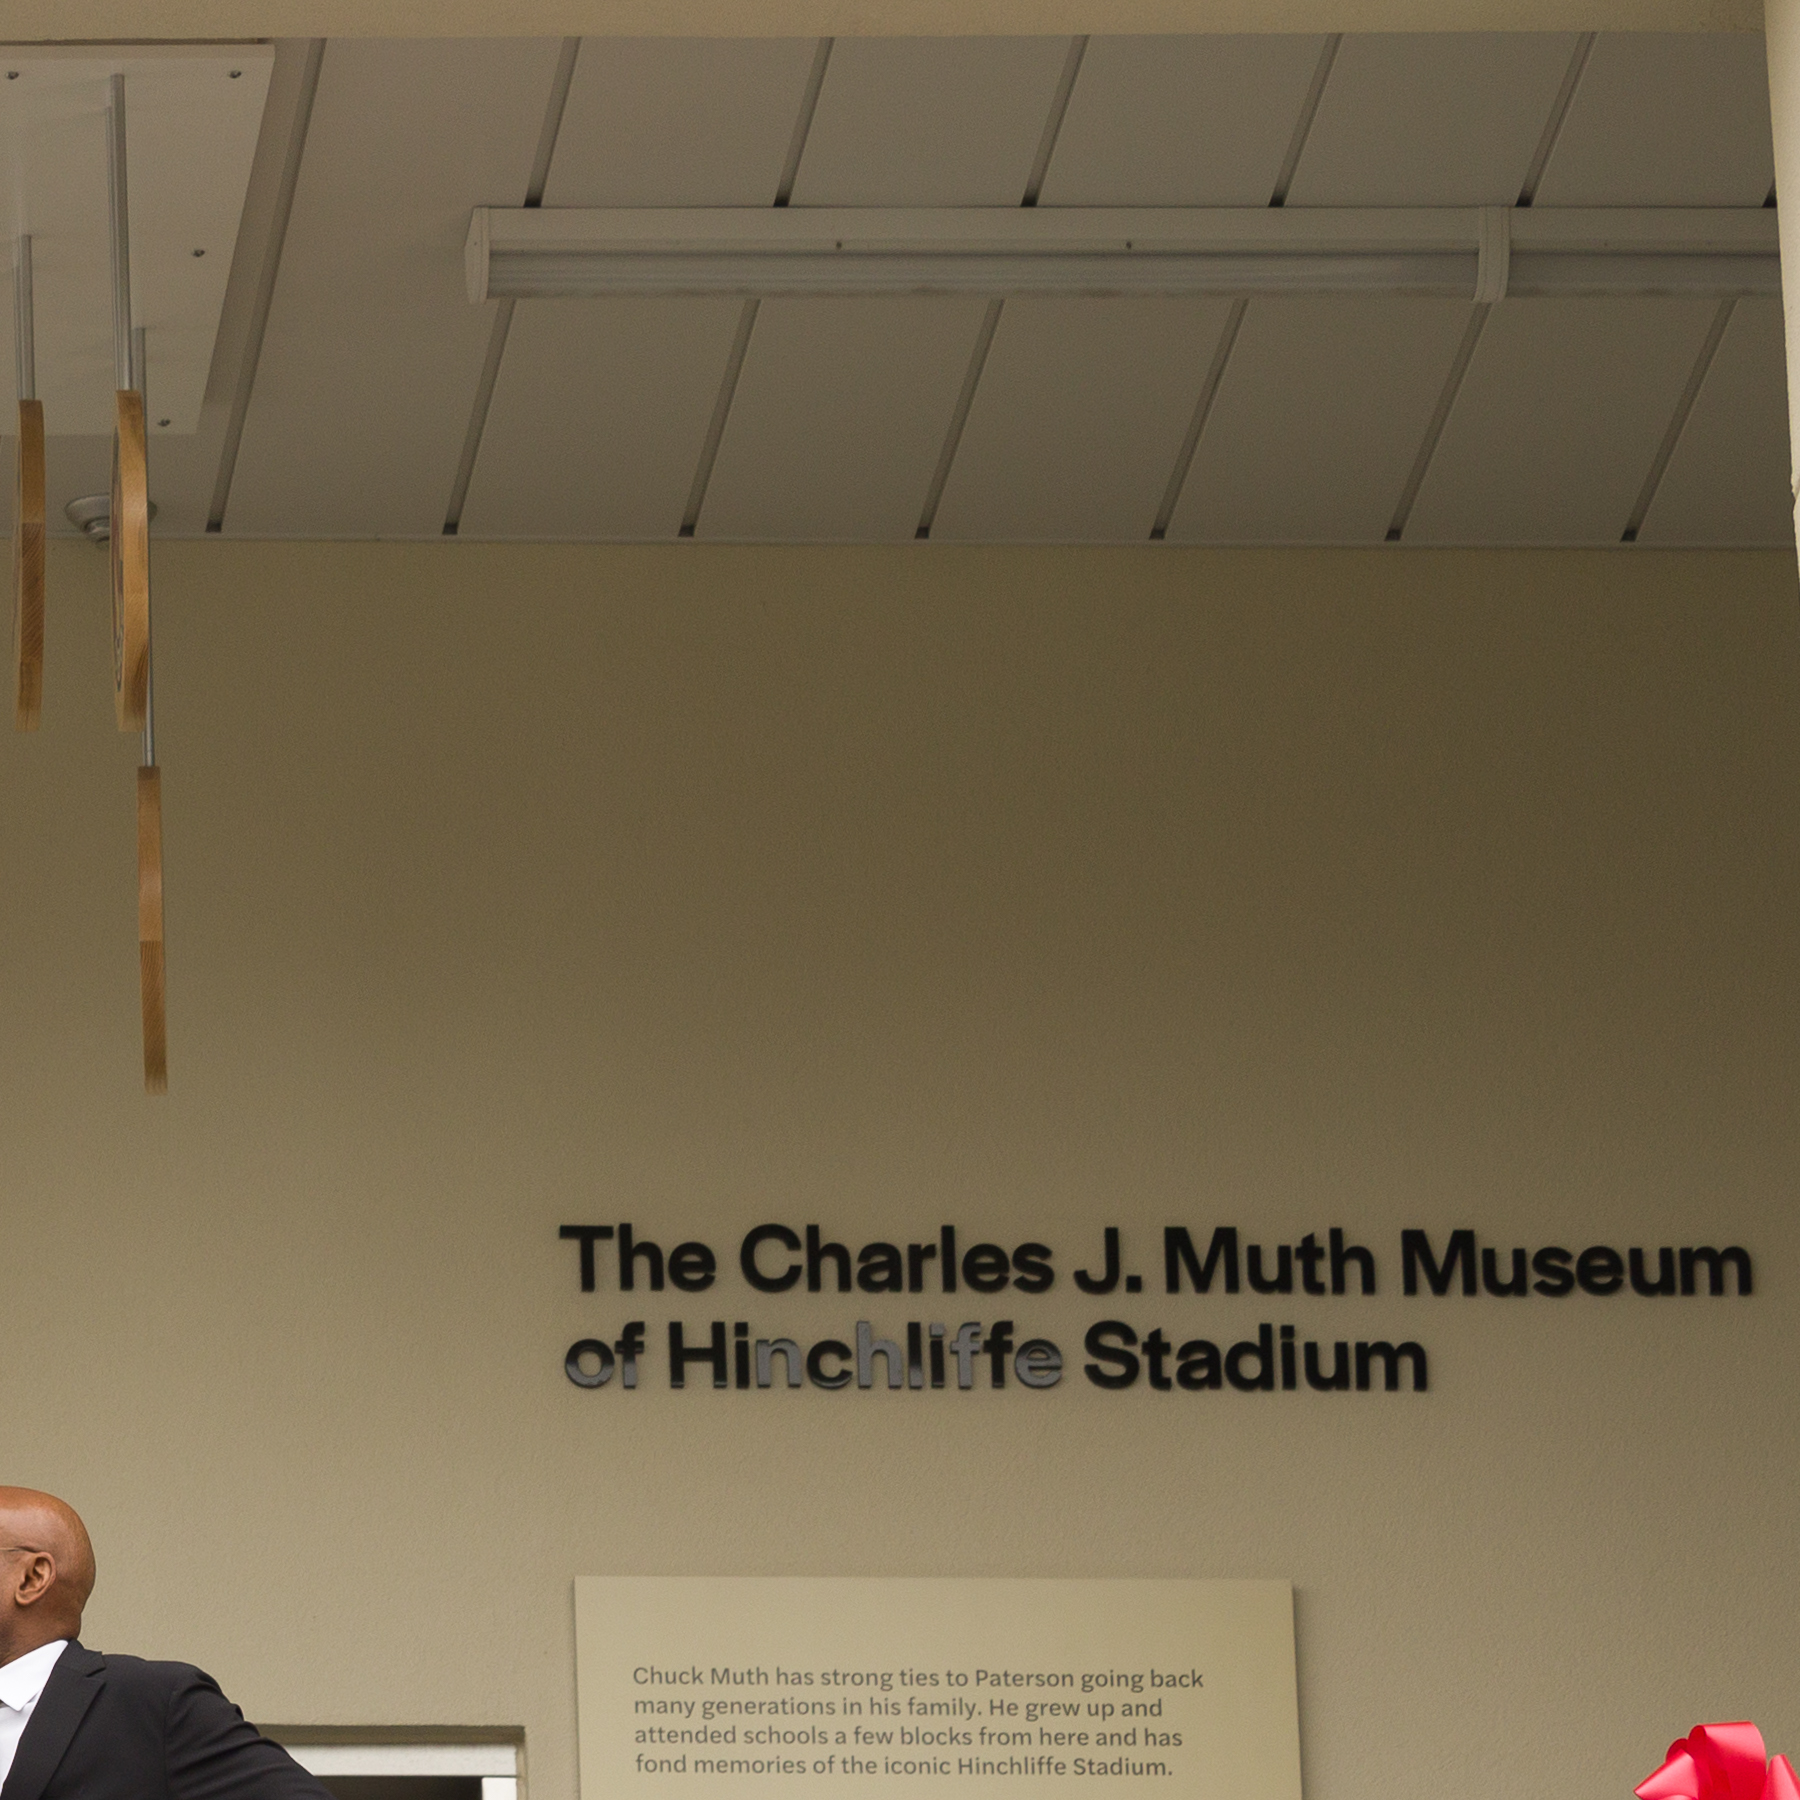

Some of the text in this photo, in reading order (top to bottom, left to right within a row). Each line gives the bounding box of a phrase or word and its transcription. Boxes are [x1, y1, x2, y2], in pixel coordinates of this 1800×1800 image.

[559, 1223, 1753, 1297] The Charles J. Muth Museum
[564, 1320, 1429, 1392] of Hinchliffe Stadium
[632, 1665, 1204, 1694] Chuck Muth has strong ties to Paterson going back
[634, 1695, 1163, 1723] many generations in his family. He grew up and
[634, 1724, 1183, 1748] attended schools a few blocks from here and has
[635, 1752, 1173, 1777] fond memories of the iconic Hinchliffe Stadium.
